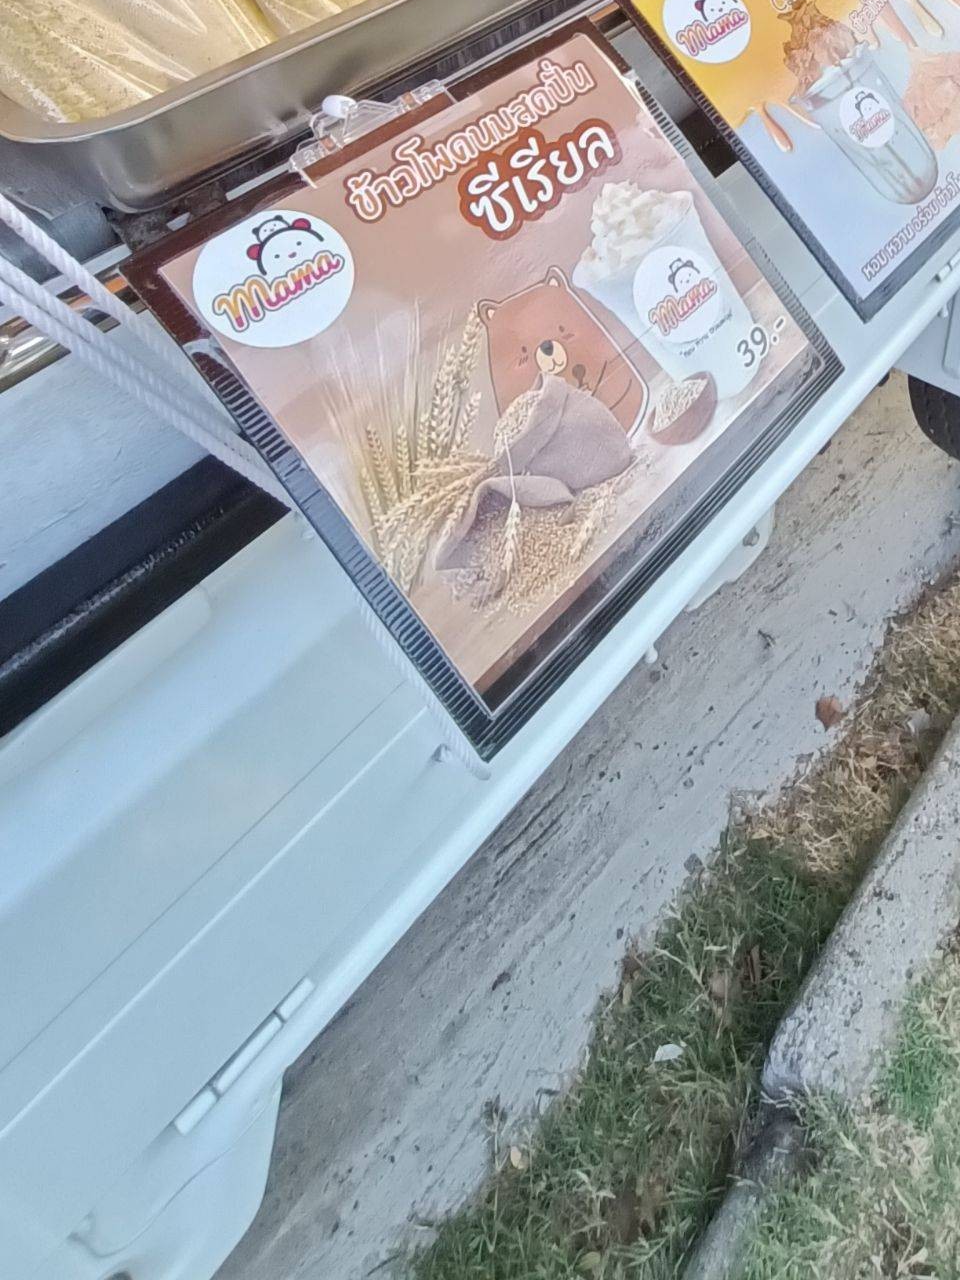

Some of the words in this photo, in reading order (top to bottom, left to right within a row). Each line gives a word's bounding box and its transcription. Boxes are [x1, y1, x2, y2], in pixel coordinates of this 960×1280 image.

[676, 8, 749, 57] Mama
[346, 59, 596, 221] ข้าวโพดนมสดปั่น
[466, 126, 616, 233] ซีเรียล
[212, 249, 346, 333] Mama
[648, 276, 718, 337] Mama
